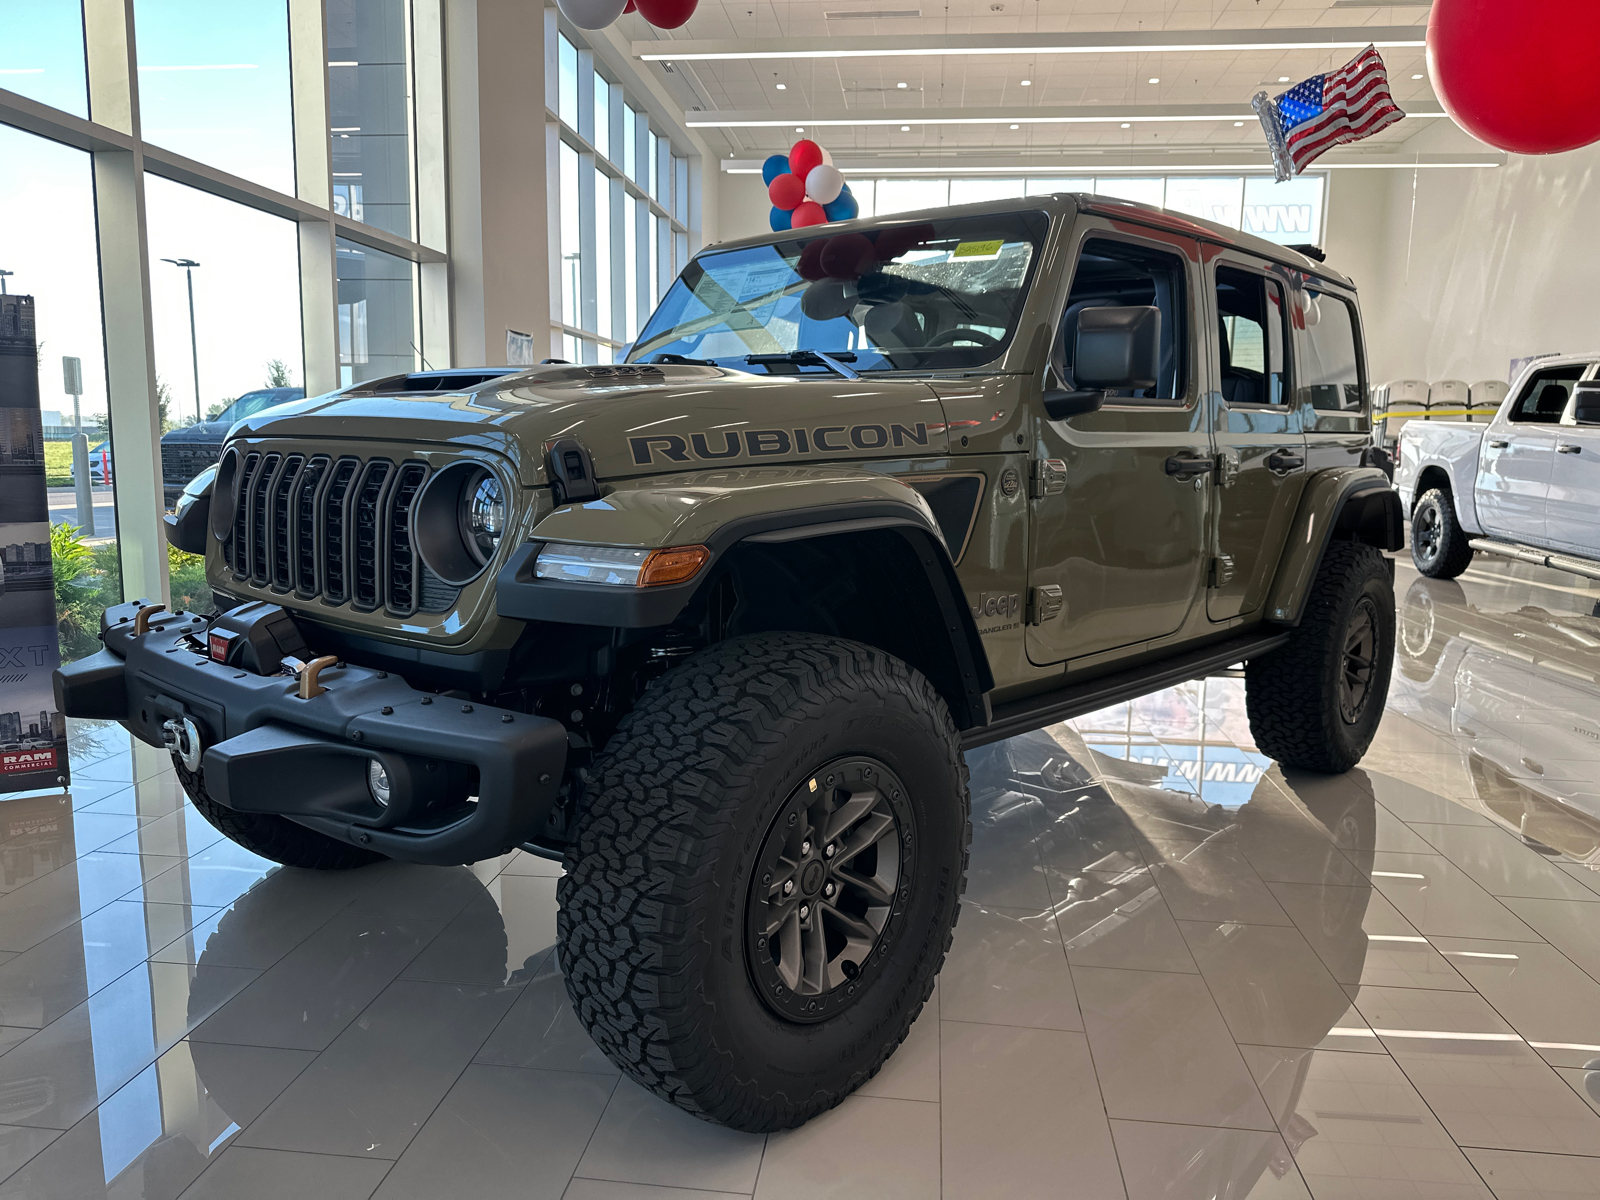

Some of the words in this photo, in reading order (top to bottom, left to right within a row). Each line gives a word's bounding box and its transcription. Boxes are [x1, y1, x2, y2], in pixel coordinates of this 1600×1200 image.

[625, 421, 931, 467] RUBICON
[972, 592, 1021, 620] Jeep
[978, 623, 1013, 636] RANGLER
[3, 752, 52, 764] RAM
[4, 761, 53, 771] COMMERCIAL
